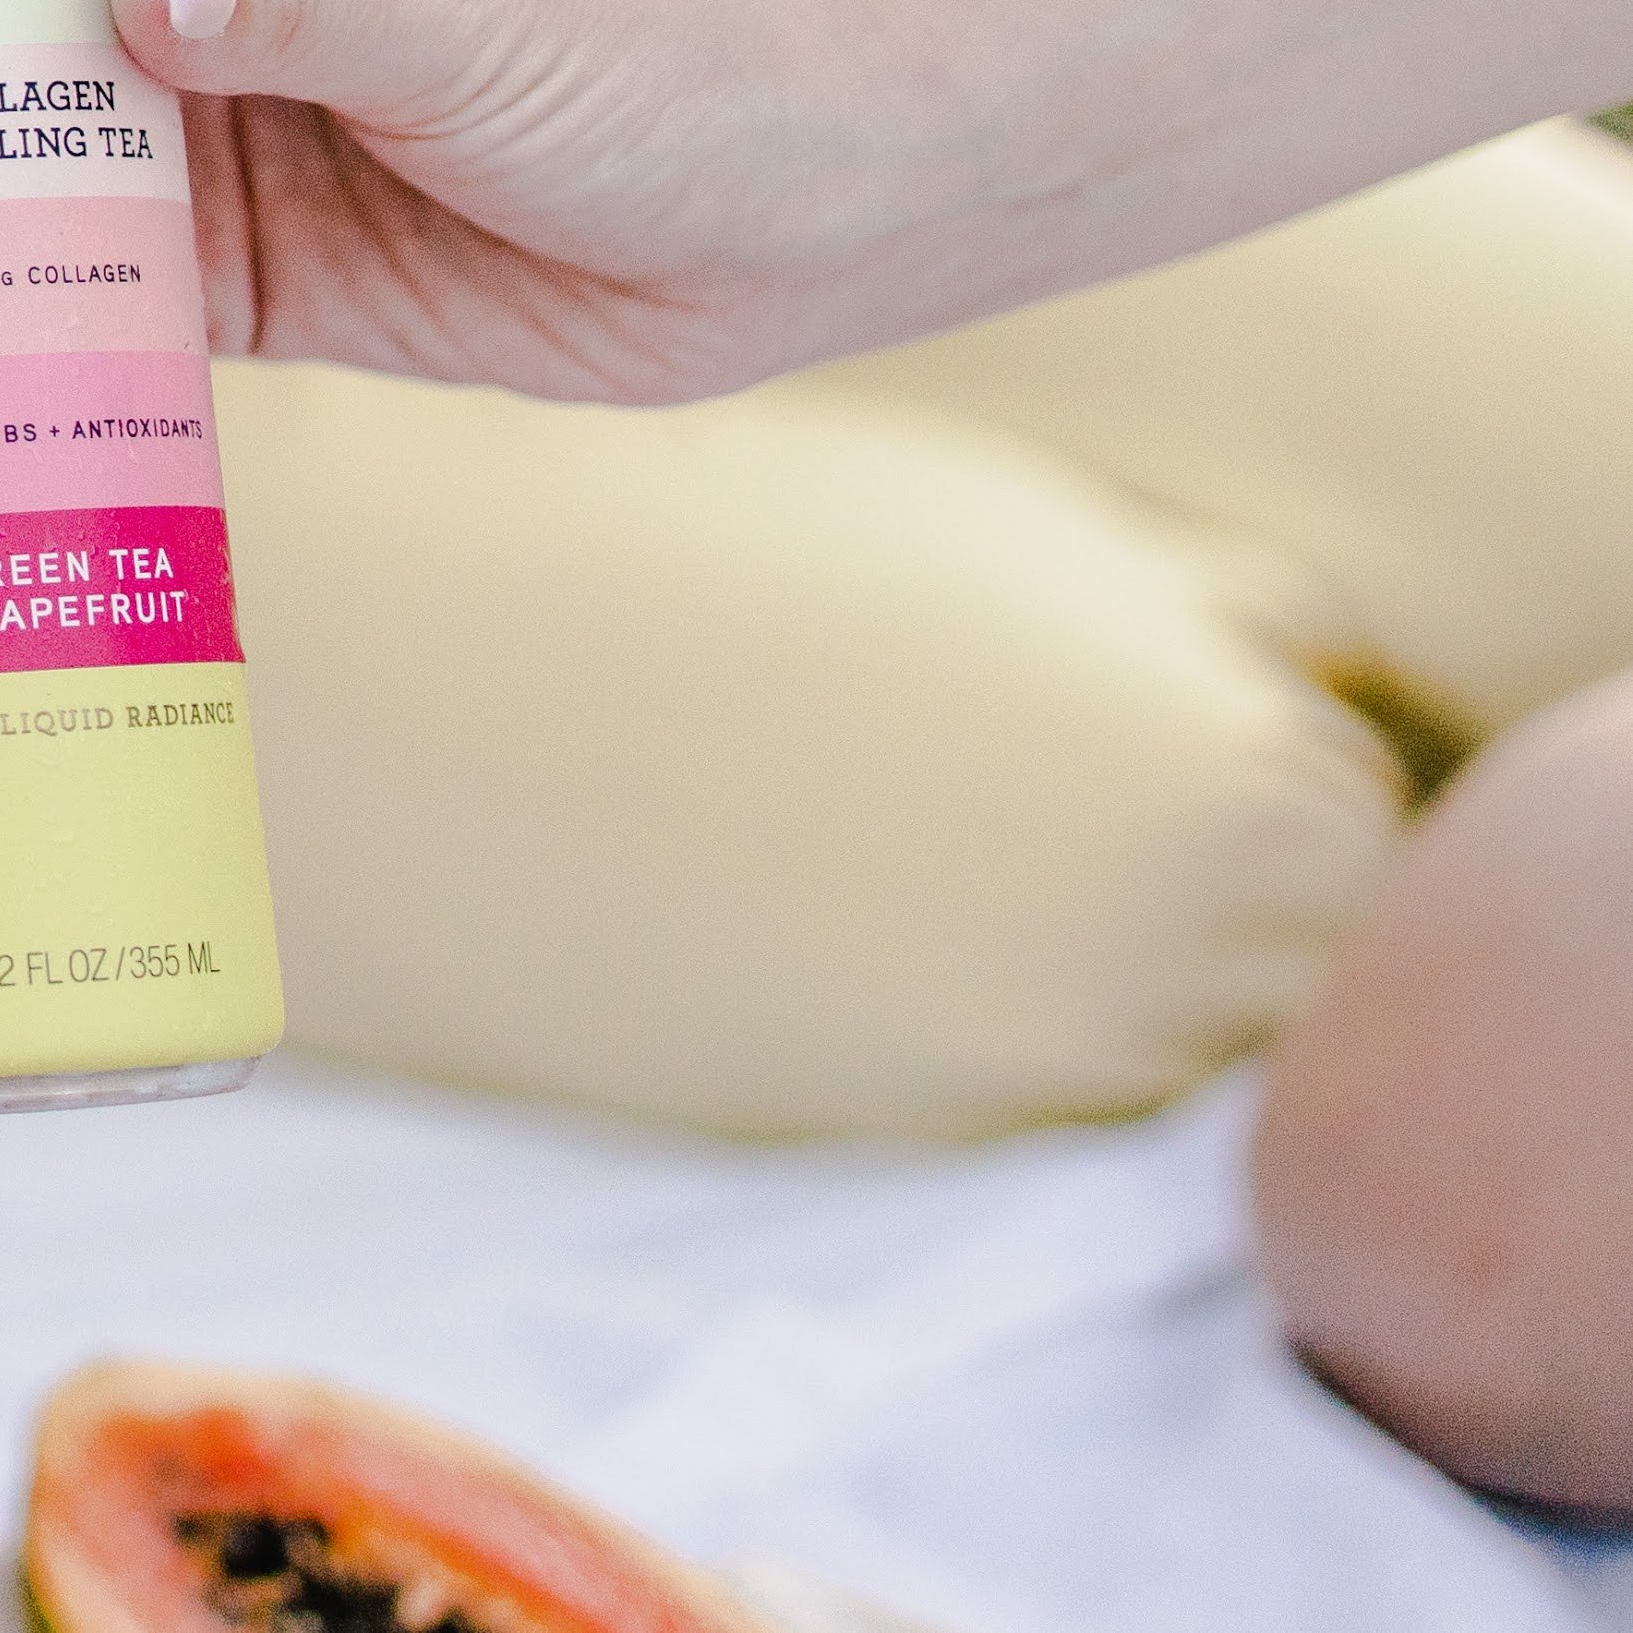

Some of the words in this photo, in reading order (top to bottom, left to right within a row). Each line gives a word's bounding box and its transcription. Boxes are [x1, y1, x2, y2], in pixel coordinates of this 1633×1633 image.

[98, 128, 154, 159] TEA
[28, 264, 141, 285] COLLAGEN
[72, 418, 203, 440] ANTIOXIDANTS
[109, 547, 174, 580] TEA
[0, 707, 114, 737] LIQUID
[125, 702, 235, 728] RADIANCE
[27, 951, 63, 985] FL
[188, 941, 221, 975] ML
